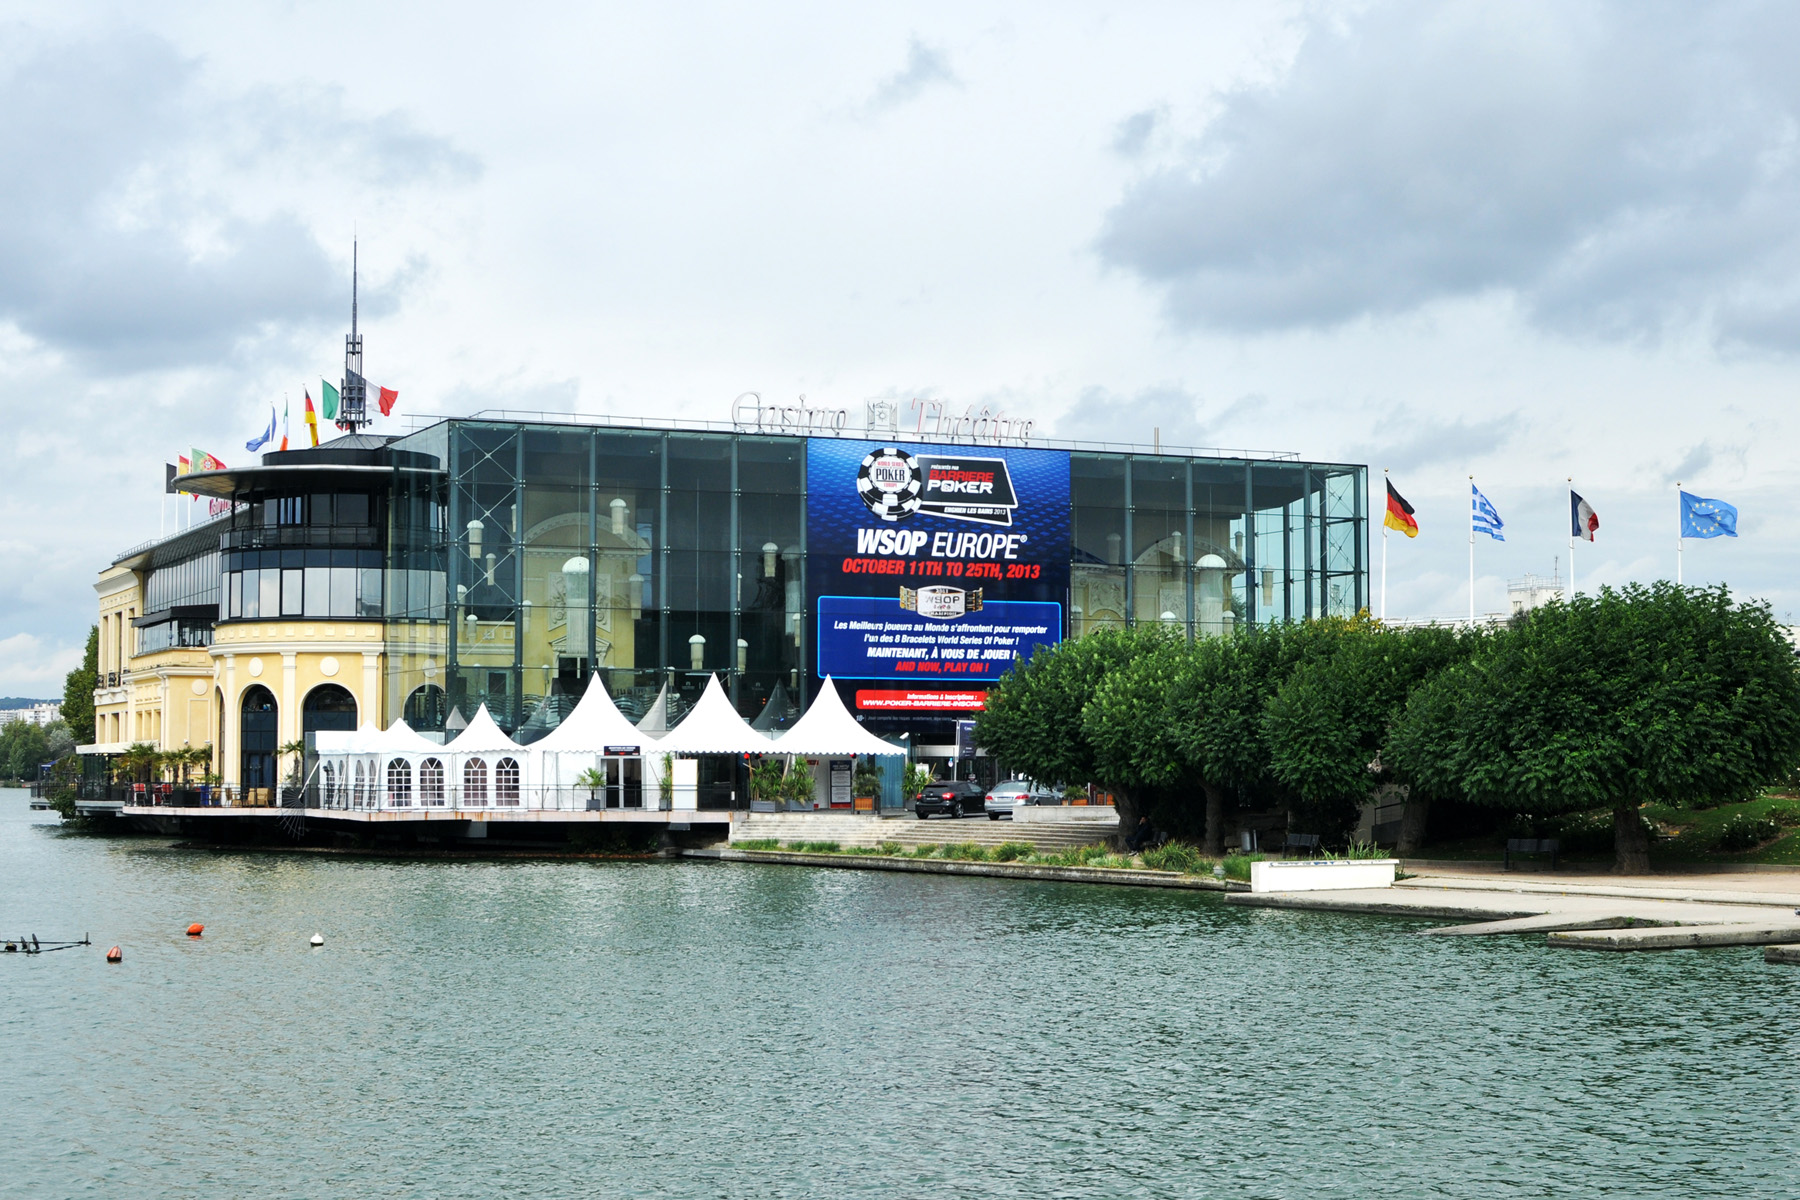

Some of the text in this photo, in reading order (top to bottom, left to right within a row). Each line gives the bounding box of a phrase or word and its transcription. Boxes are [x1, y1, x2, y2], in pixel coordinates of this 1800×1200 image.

[732, 391, 850, 434] Casino
[876, 468, 905, 481] POKER
[929, 469, 995, 483] BARRIERE
[927, 479, 994, 494] POKER
[857, 528, 928, 556] WSOP
[842, 558, 1041, 581] OCTOBER 11TH TO 25TH, 2013
[834, 620, 848, 630] Les
[849, 621, 883, 630] Meilleurs
[913, 623, 923, 631] au
[924, 623, 949, 632] Monde
[950, 624, 993, 633] s'affrontent
[993, 626, 1011, 635] pour
[1011, 625, 1048, 635] remporter
[880, 634, 894, 643] des
[894, 634, 901, 643] 8
[901, 635, 936, 644] Bracelets
[937, 635, 959, 645] World
[959, 636, 982, 645] Series
[983, 636, 992, 645] Of
[993, 637, 1015, 646] Poker
[1015, 637, 1020, 646] !
[866, 646, 1017, 660] MAINTENANT, À VOUS DE JOUER !
[895, 661, 990, 674] AND NOW, PLAY ON !
